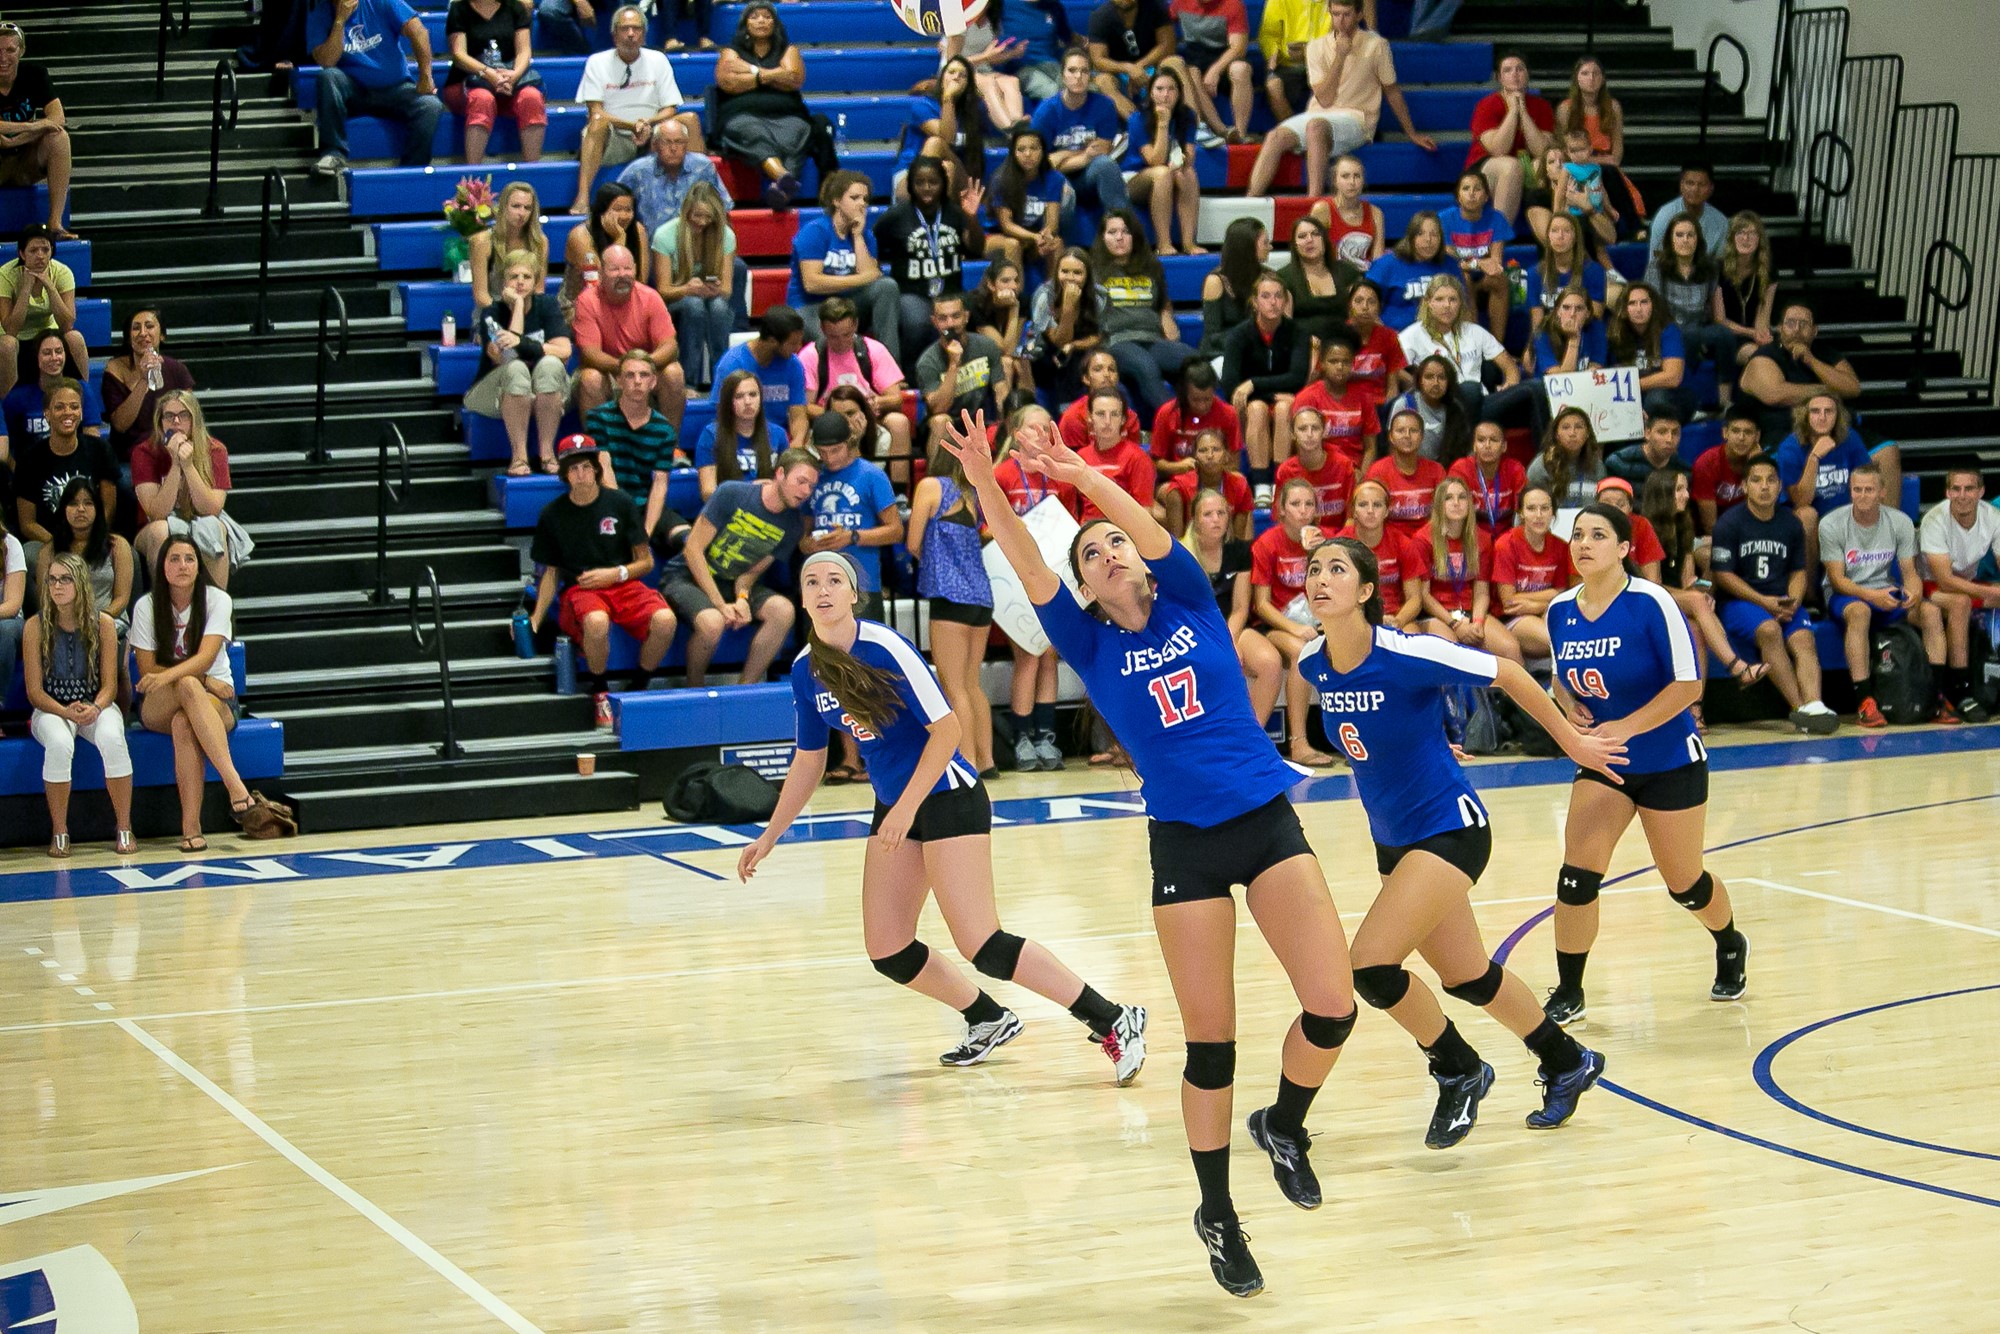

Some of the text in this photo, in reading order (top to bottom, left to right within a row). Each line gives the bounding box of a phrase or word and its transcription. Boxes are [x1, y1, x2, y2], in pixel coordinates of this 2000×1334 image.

[26, 418, 51, 433] JES
[814, 512, 863, 528] OJECT
[1757, 555, 1770, 580] 5
[1120, 624, 1198, 677] JESSUP
[1557, 636, 1622, 660] JESSUP
[1567, 667, 1610, 700] 19
[815, 691, 841, 713] JES
[1148, 665, 1205, 729] 17
[1320, 690, 1385, 713] JESSUP
[1338, 722, 1369, 761] 6
